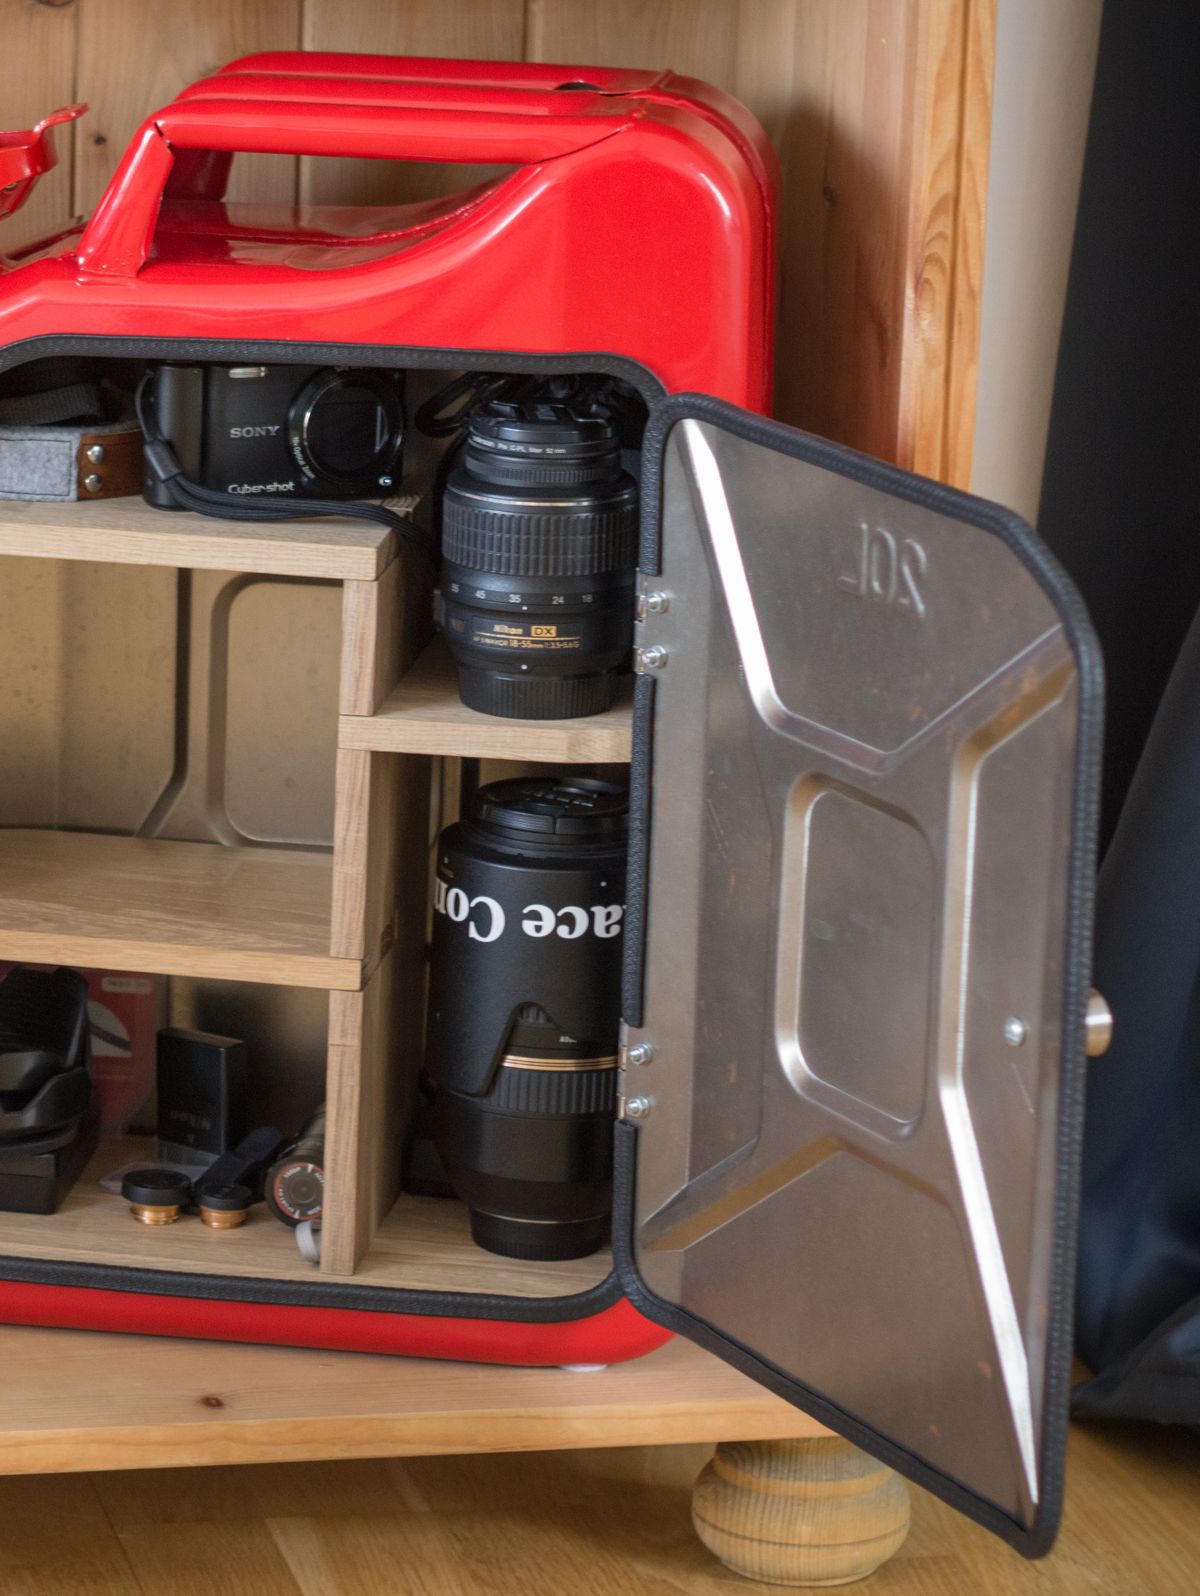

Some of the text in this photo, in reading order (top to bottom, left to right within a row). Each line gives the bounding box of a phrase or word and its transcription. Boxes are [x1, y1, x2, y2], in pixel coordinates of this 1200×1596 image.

[230, 425, 281, 439] SONY
[228, 480, 296, 495] Cyber-shot
[508, 593, 522, 604] 35
[551, 595, 565, 606] 24
[493, 624, 555, 637] Nikon DX
[522, 904, 627, 939] ace
